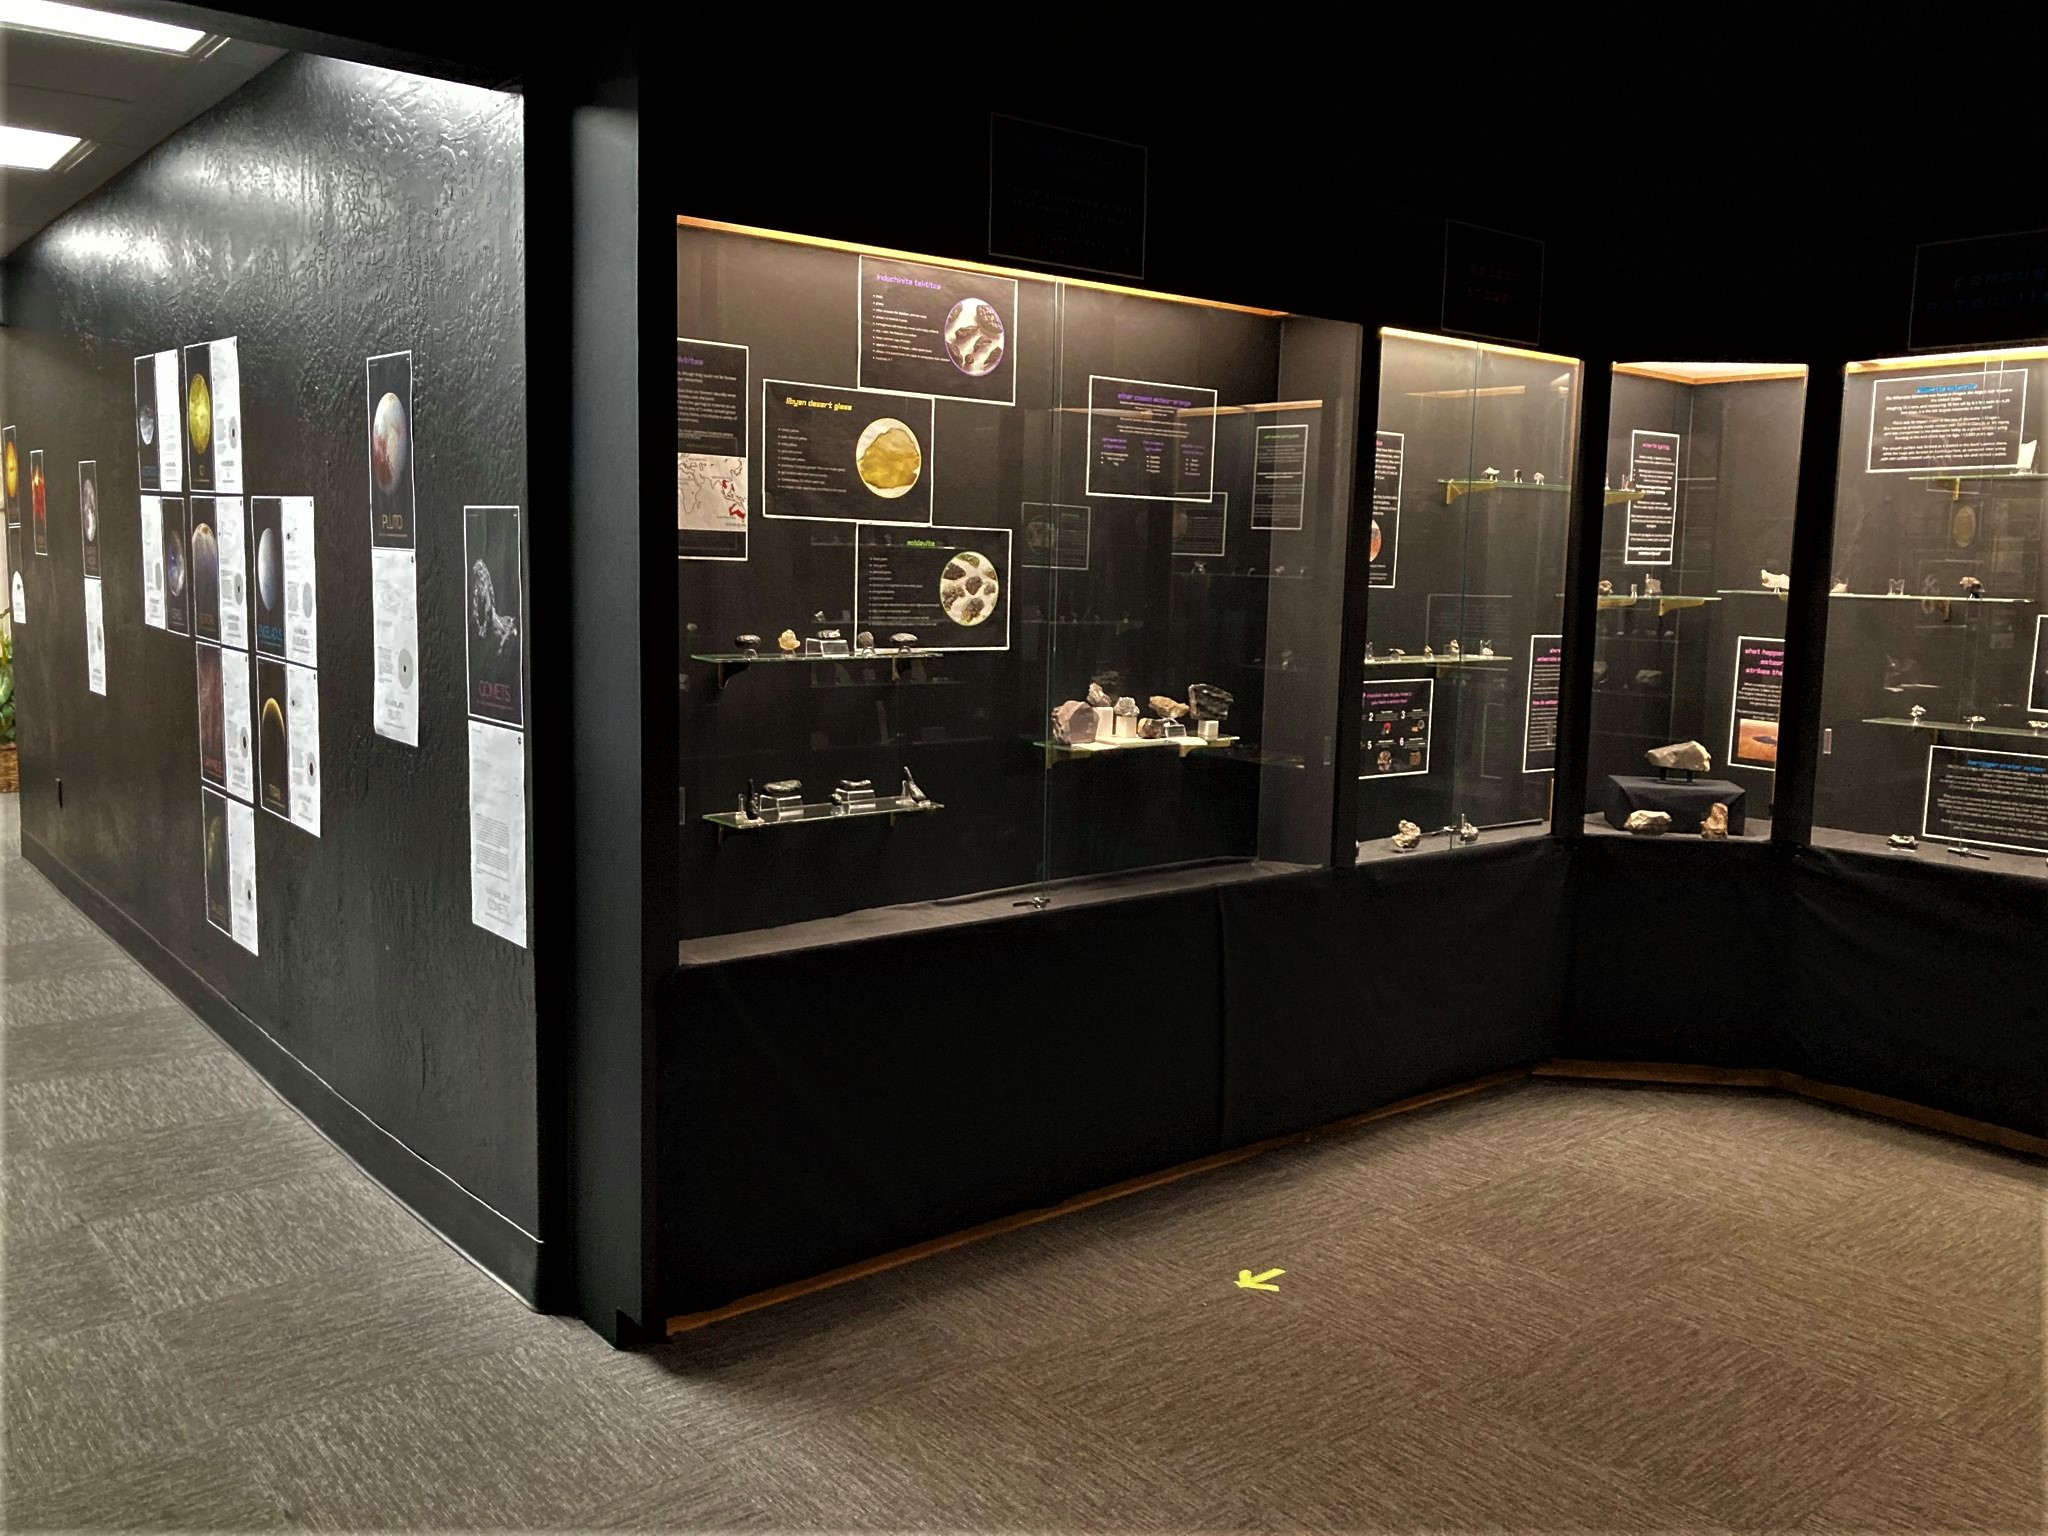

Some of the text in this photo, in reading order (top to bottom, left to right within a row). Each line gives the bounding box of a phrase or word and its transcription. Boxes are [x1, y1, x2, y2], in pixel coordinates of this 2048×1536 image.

[382, 514, 403, 530] PLUTO
[479, 680, 511, 702] COMETS
[1368, 712, 1374, 722] 2
[1400, 710, 1406, 719] 3
[1367, 740, 1373, 750] 5
[1399, 737, 1405, 746] 6
